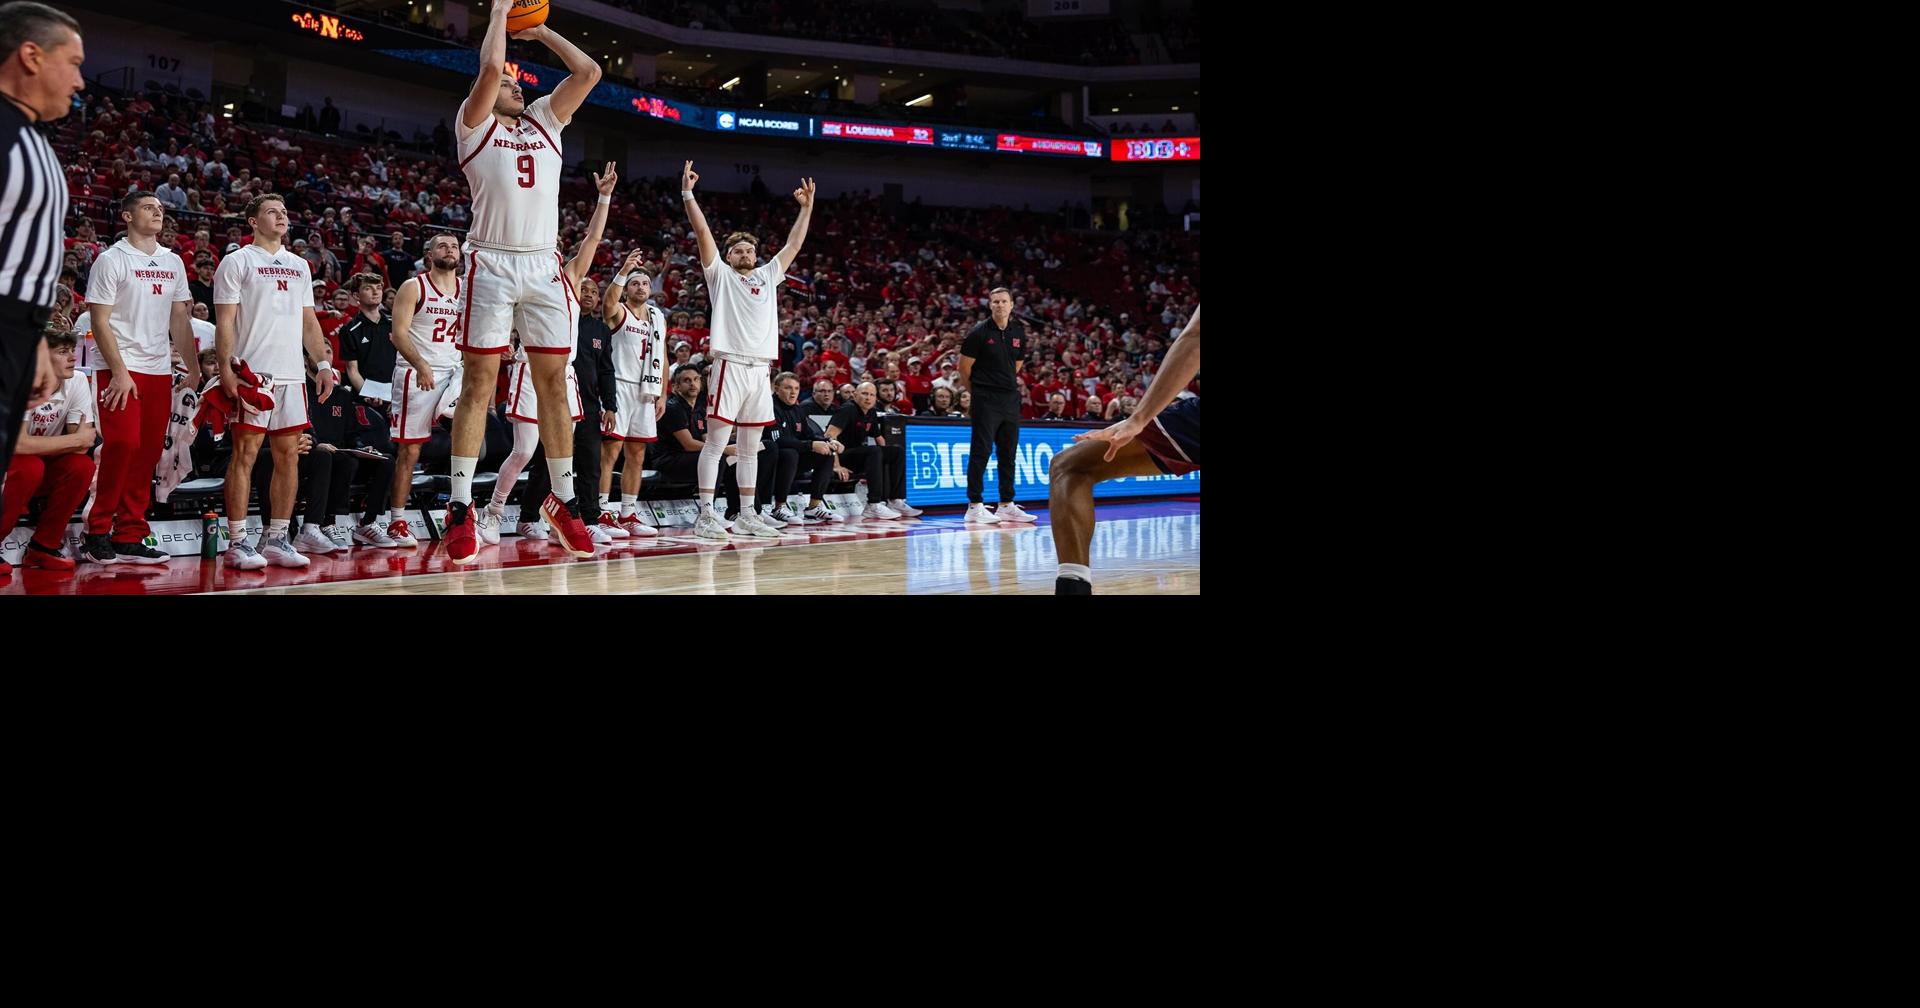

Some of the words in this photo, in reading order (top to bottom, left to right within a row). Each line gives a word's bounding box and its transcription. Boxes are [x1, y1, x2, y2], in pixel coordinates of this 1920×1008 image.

[148, 54, 180, 72] 107
[739, 117, 764, 127] NCAA
[517, 154, 535, 188] 9
[135, 270, 175, 279] NEBRASKA
[257, 267, 301, 278] NEBRASKA
[152, 283, 162, 295] N
[277, 279, 288, 291] N
[751, 287, 760, 295] N
[432, 318, 458, 343] 24
